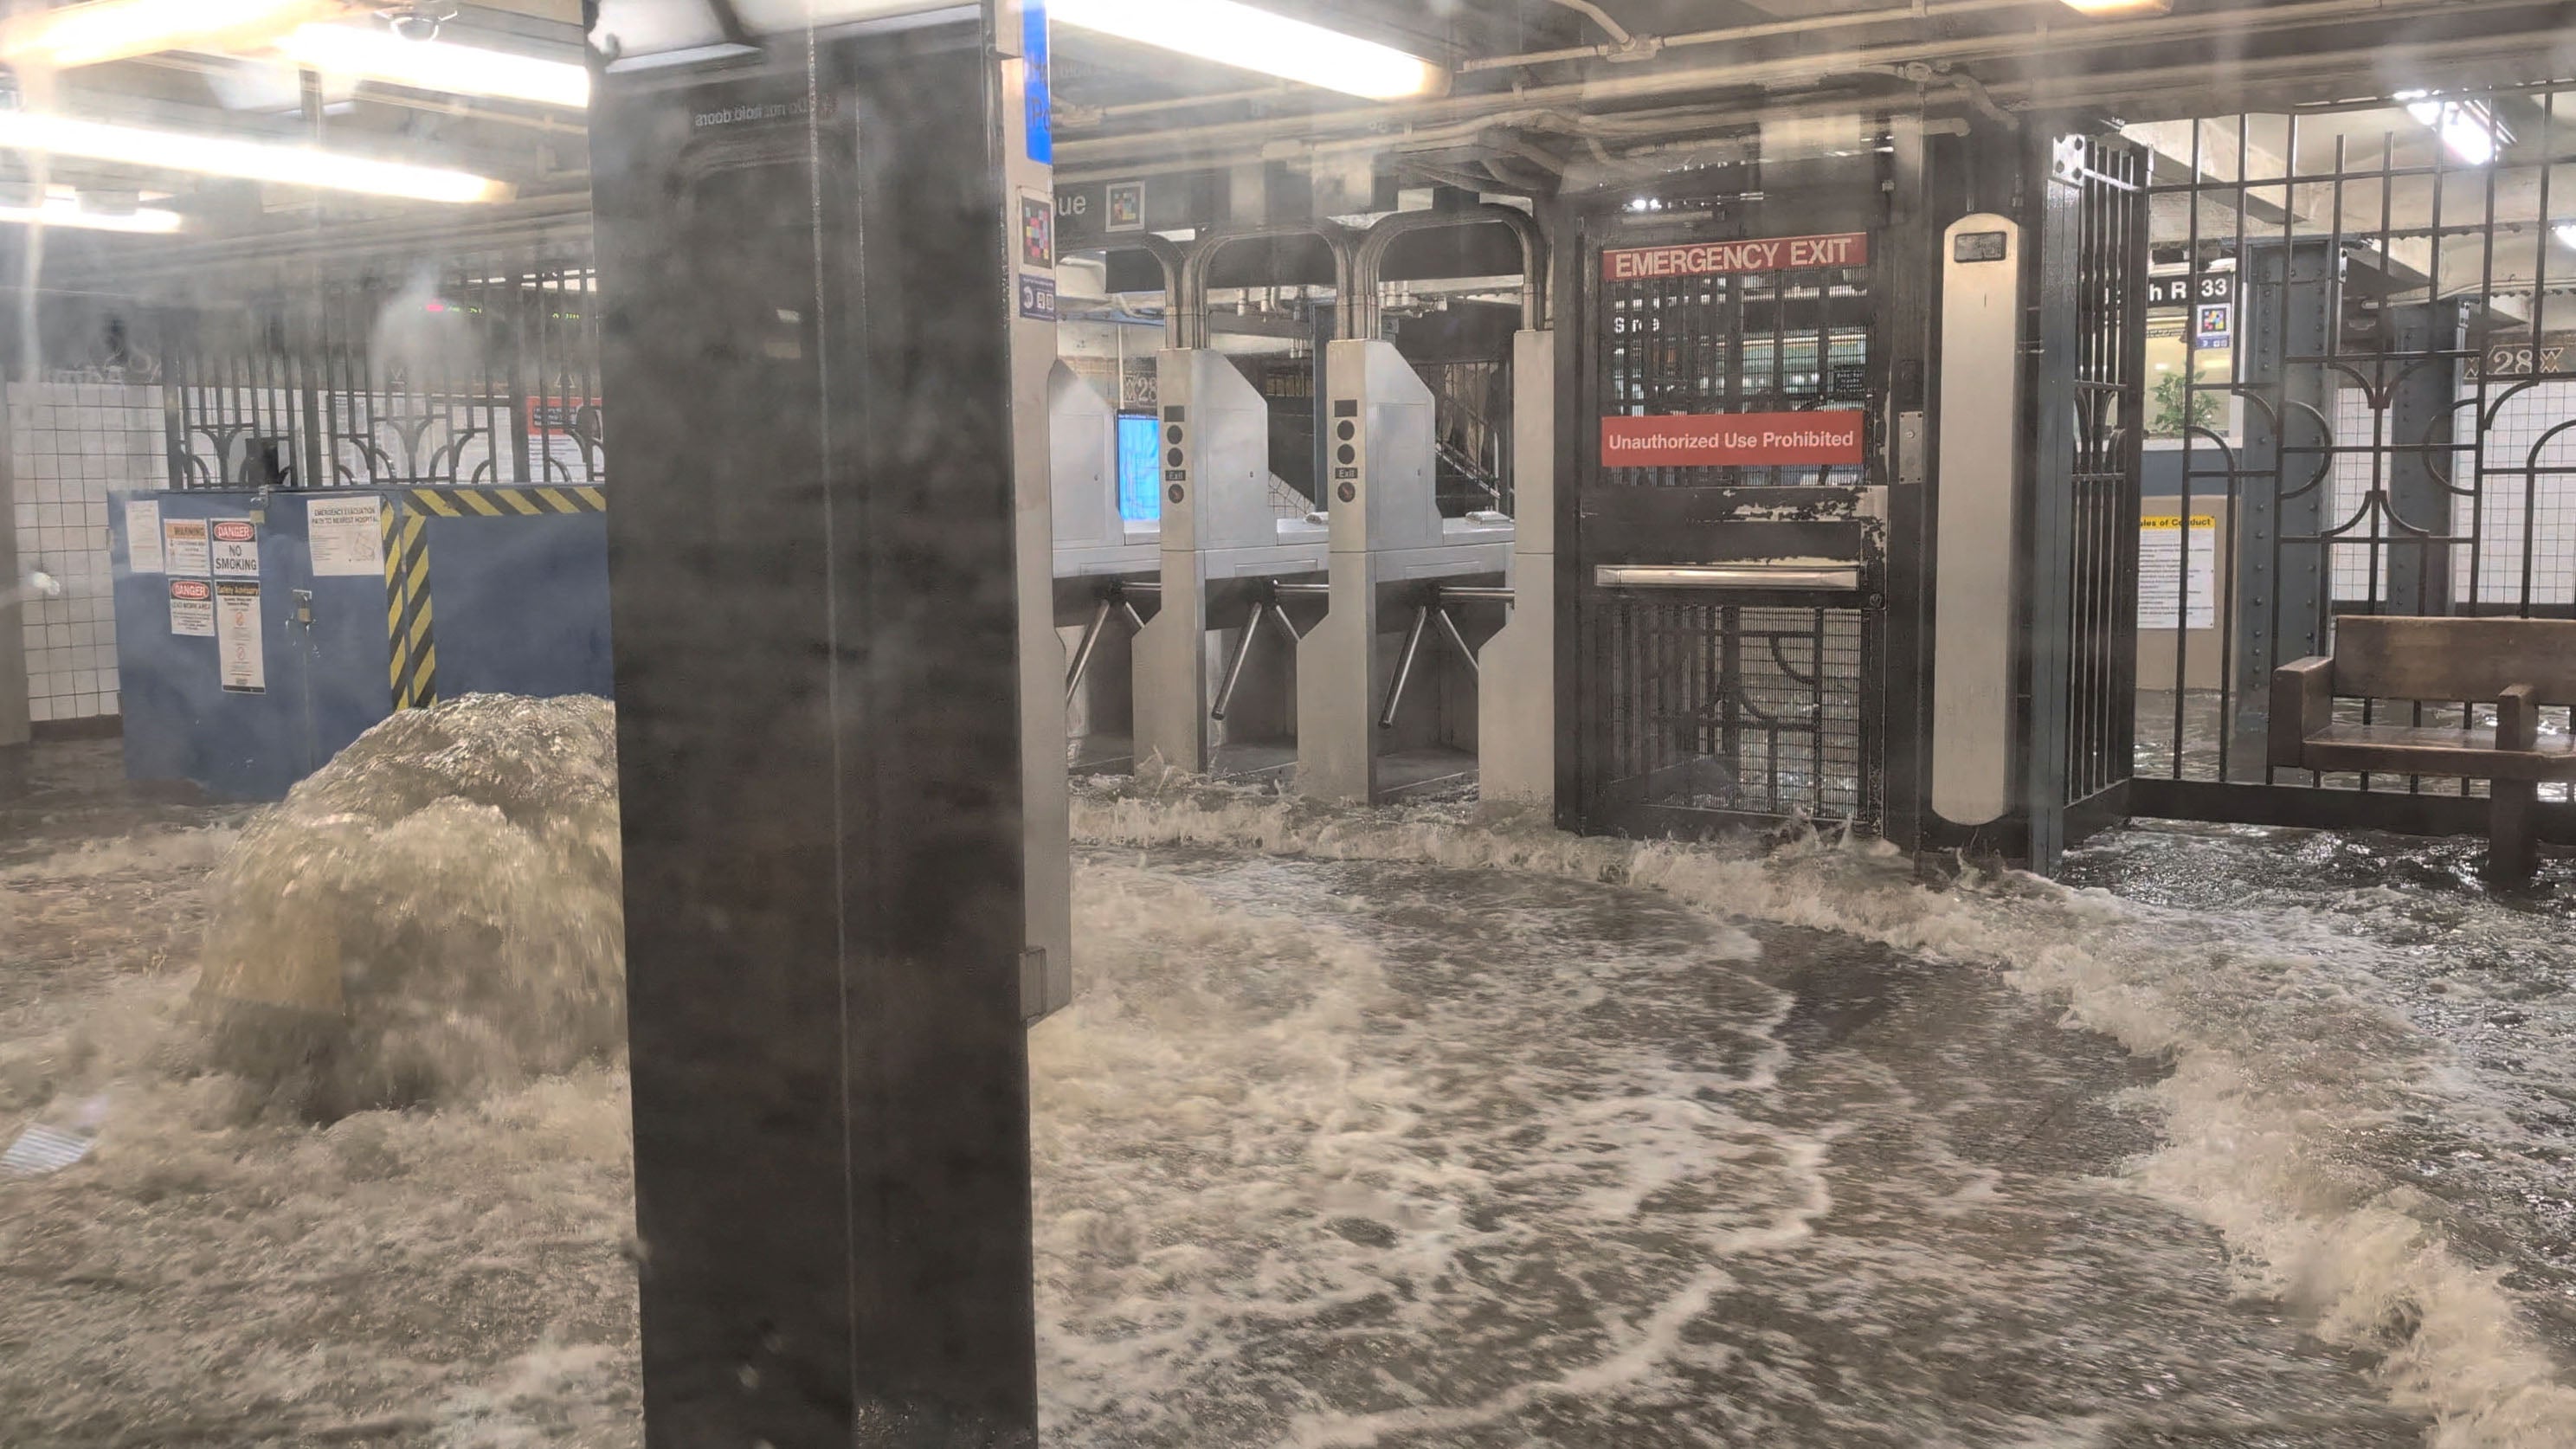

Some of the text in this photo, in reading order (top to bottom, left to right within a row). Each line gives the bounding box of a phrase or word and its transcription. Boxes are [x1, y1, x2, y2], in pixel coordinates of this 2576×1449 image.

[1054, 196, 1086, 216] ue
[1615, 238, 1852, 278] EMERGENCY EXIT
[2494, 349, 2533, 375] 28
[1609, 431, 1853, 450] Unauthorized Use Prohibited
[173, 526, 206, 536] WARNING
[217, 525, 249, 538] DANGER
[229, 544, 242, 557] NO
[216, 557, 257, 570] SMOKING
[175, 583, 206, 596] DANGER
